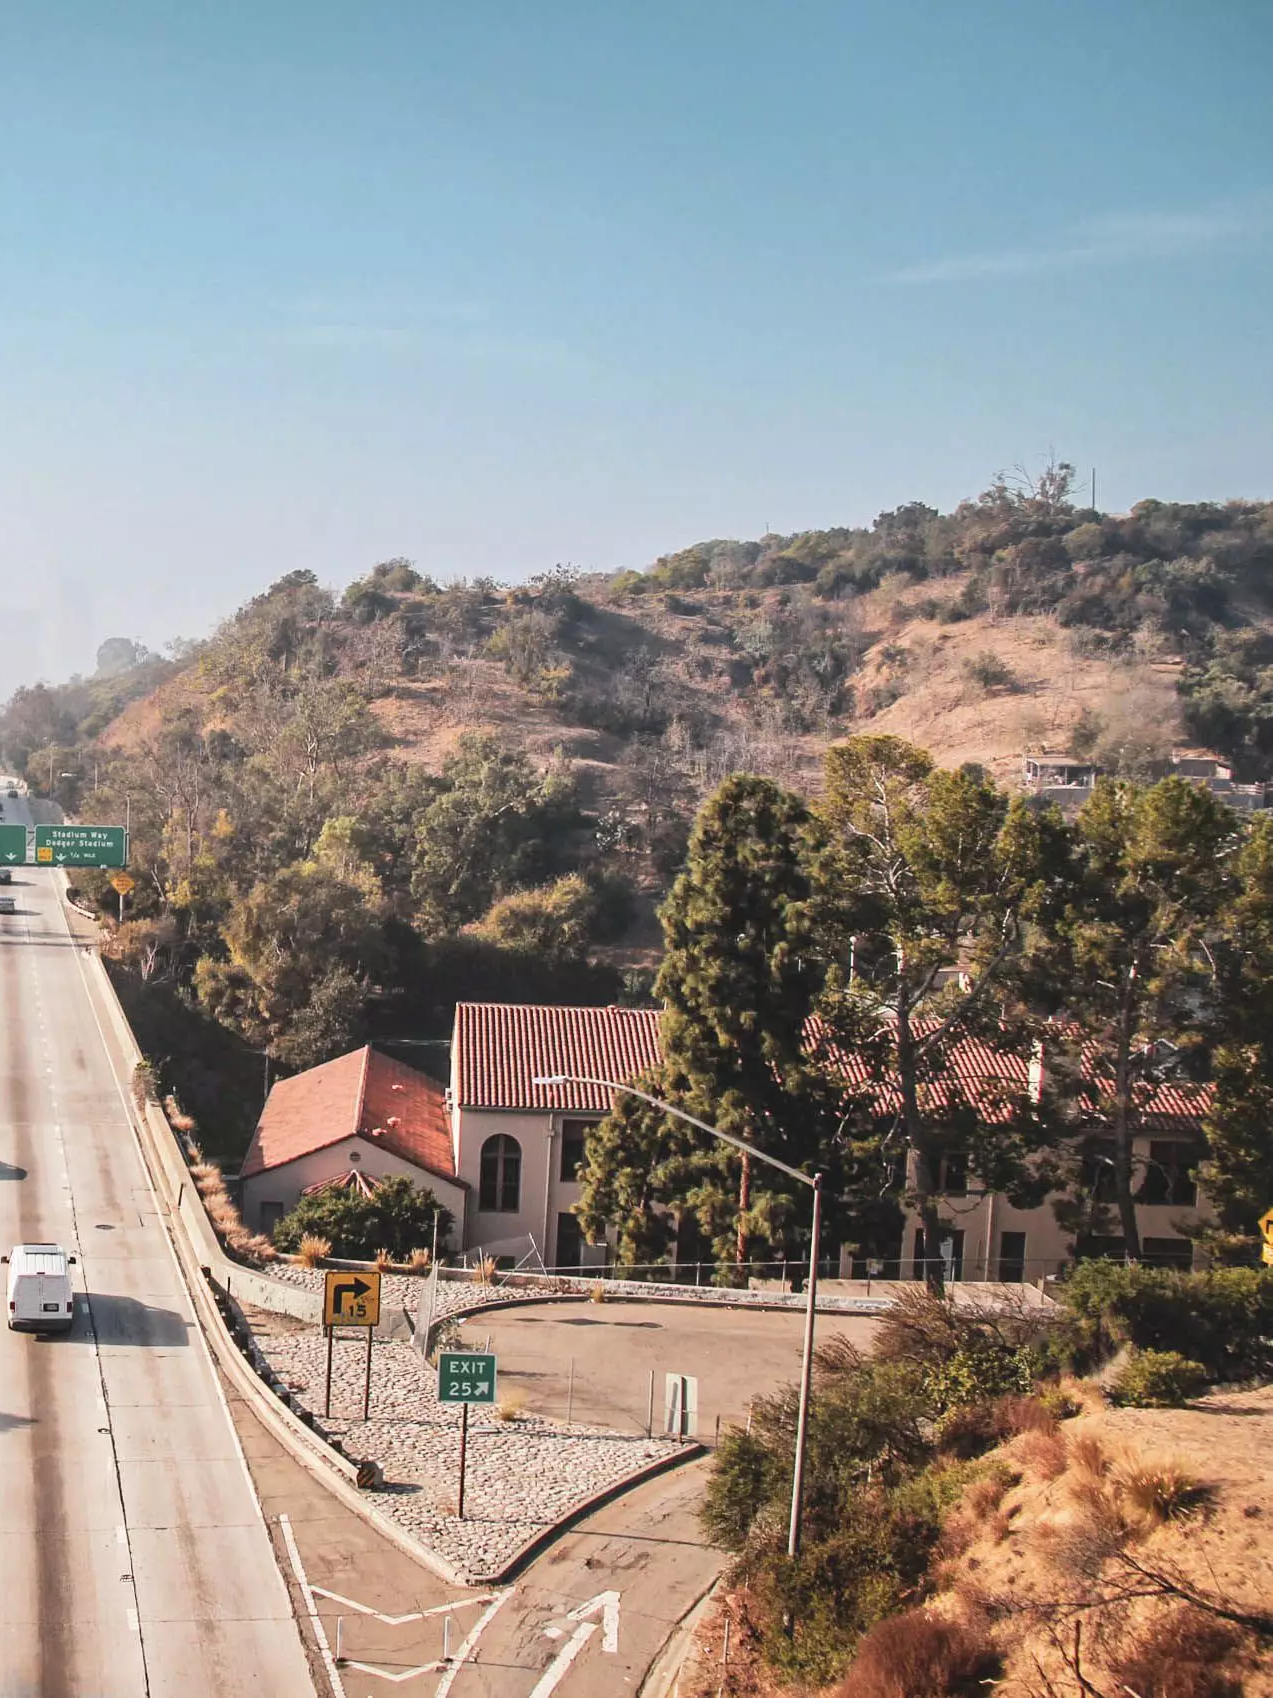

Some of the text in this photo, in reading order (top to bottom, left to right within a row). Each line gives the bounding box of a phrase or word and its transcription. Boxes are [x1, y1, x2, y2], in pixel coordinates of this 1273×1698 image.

[91, 831, 108, 840] Way
[46, 839, 75, 848] Dodger
[349, 1304, 367, 1317] 15
[449, 1361, 486, 1374] EXIT
[449, 1381, 472, 1396] 25
